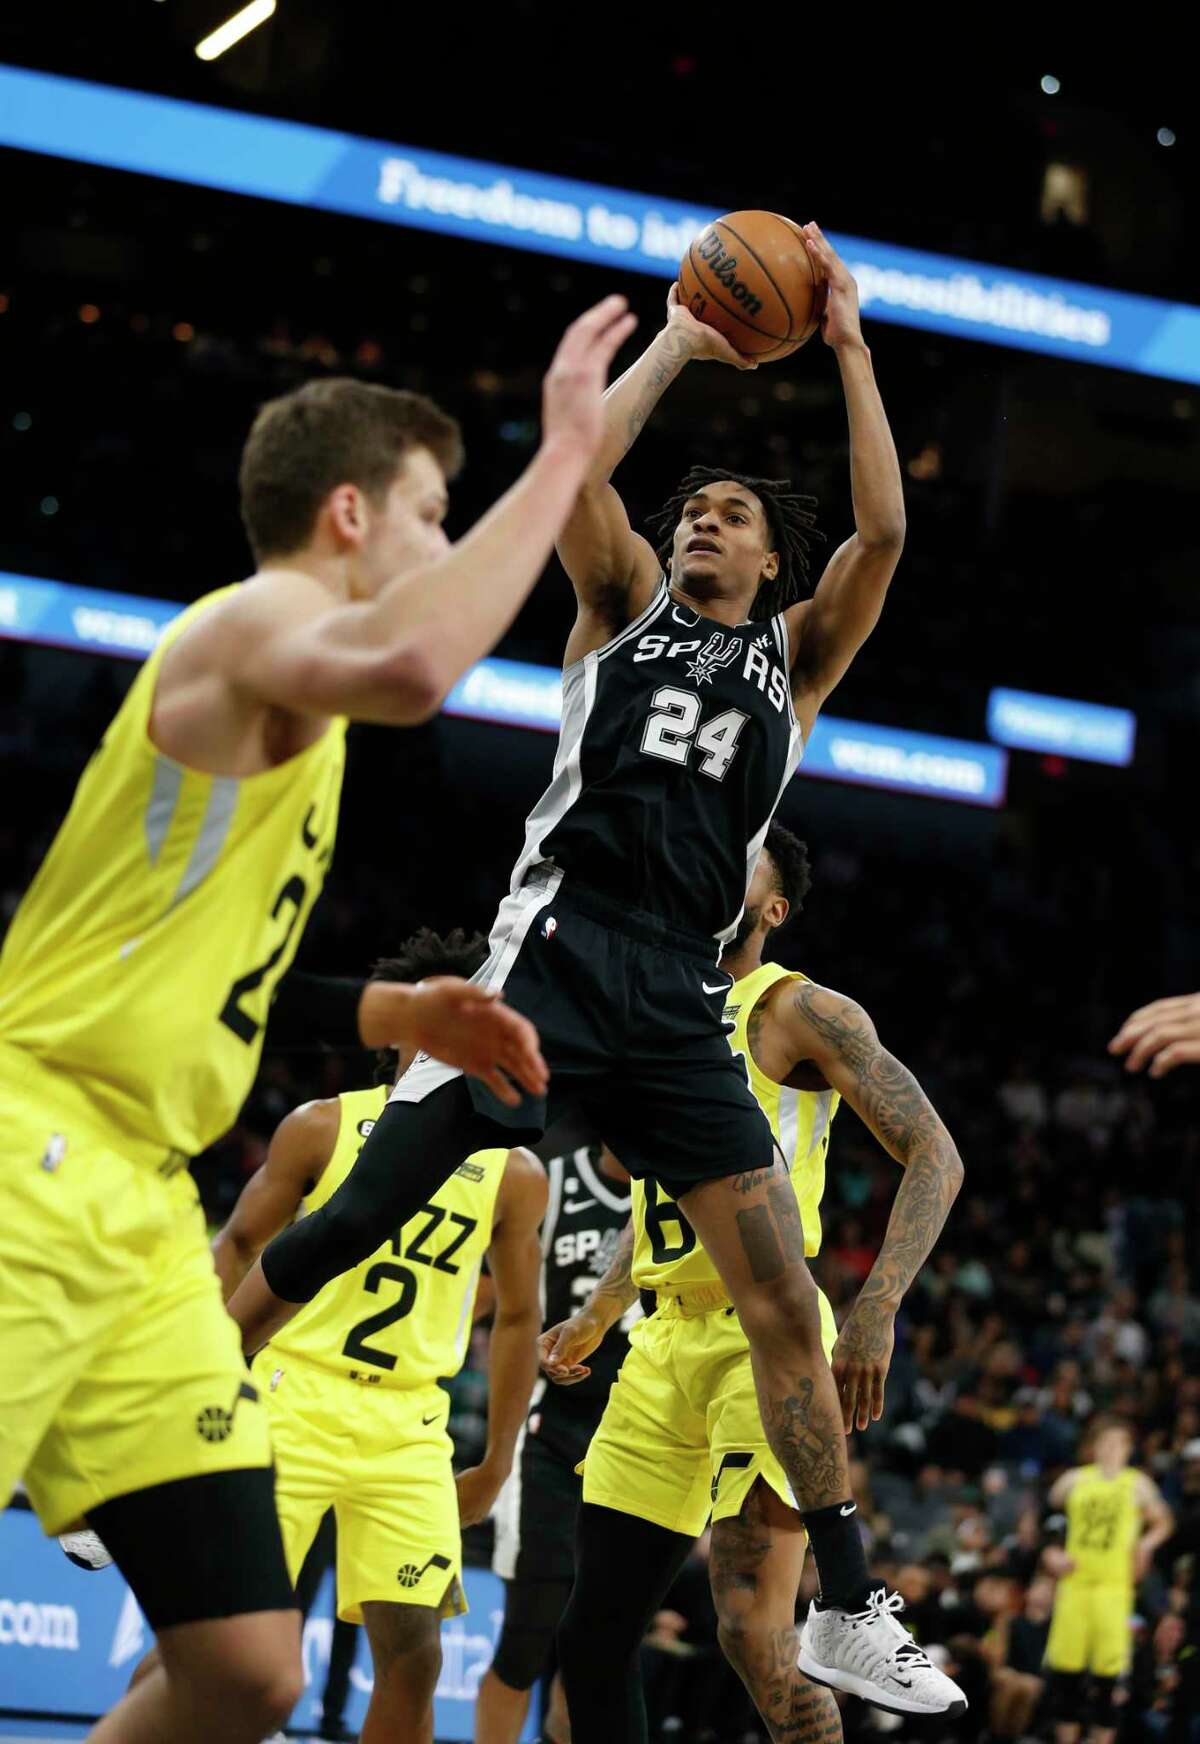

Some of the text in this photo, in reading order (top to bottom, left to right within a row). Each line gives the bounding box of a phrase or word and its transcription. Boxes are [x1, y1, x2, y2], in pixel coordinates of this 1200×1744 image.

[378, 158, 582, 241] Freedom
[587, 205, 638, 250] to
[699, 231, 762, 316] Wilson
[633, 632, 788, 713] SPURS
[640, 685, 751, 783] 24
[218, 873, 306, 1046] 2
[391, 1202, 478, 1275] ZZ
[342, 1261, 417, 1371] 2
